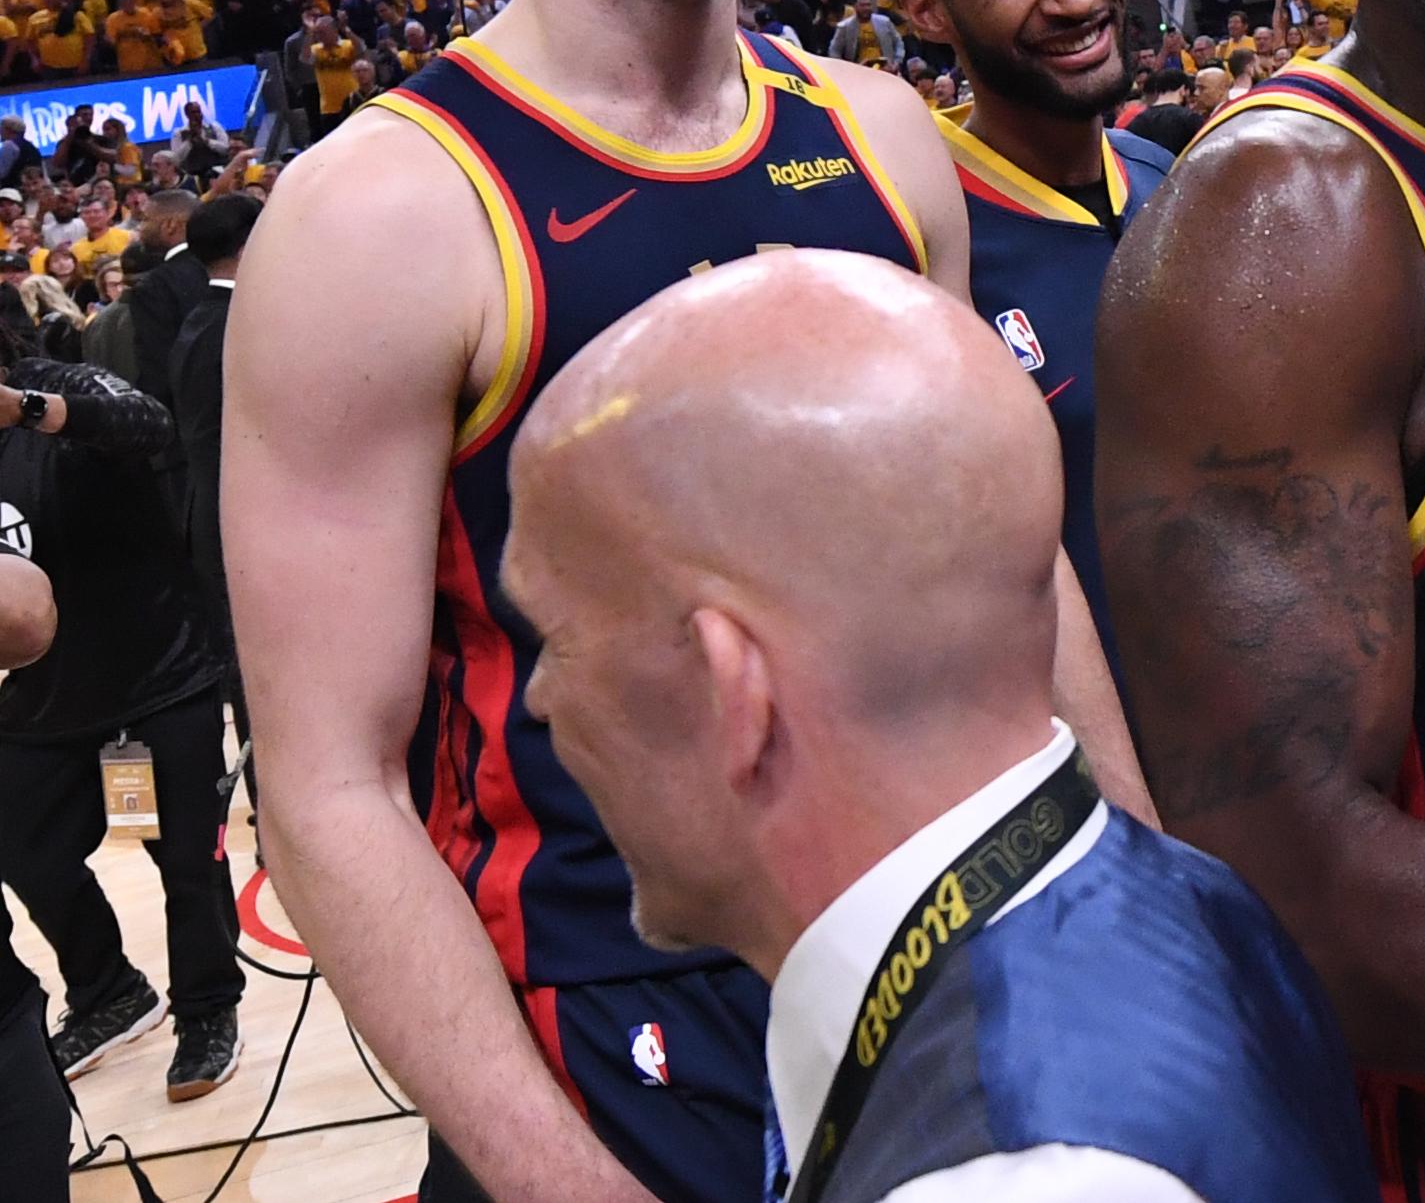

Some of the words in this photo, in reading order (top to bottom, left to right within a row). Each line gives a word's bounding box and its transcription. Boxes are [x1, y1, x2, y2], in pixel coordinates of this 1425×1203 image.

[766, 156, 856, 186] Rakuten
[957, 796, 1065, 911] GOLD
[856, 870, 972, 1068] BLOODED
